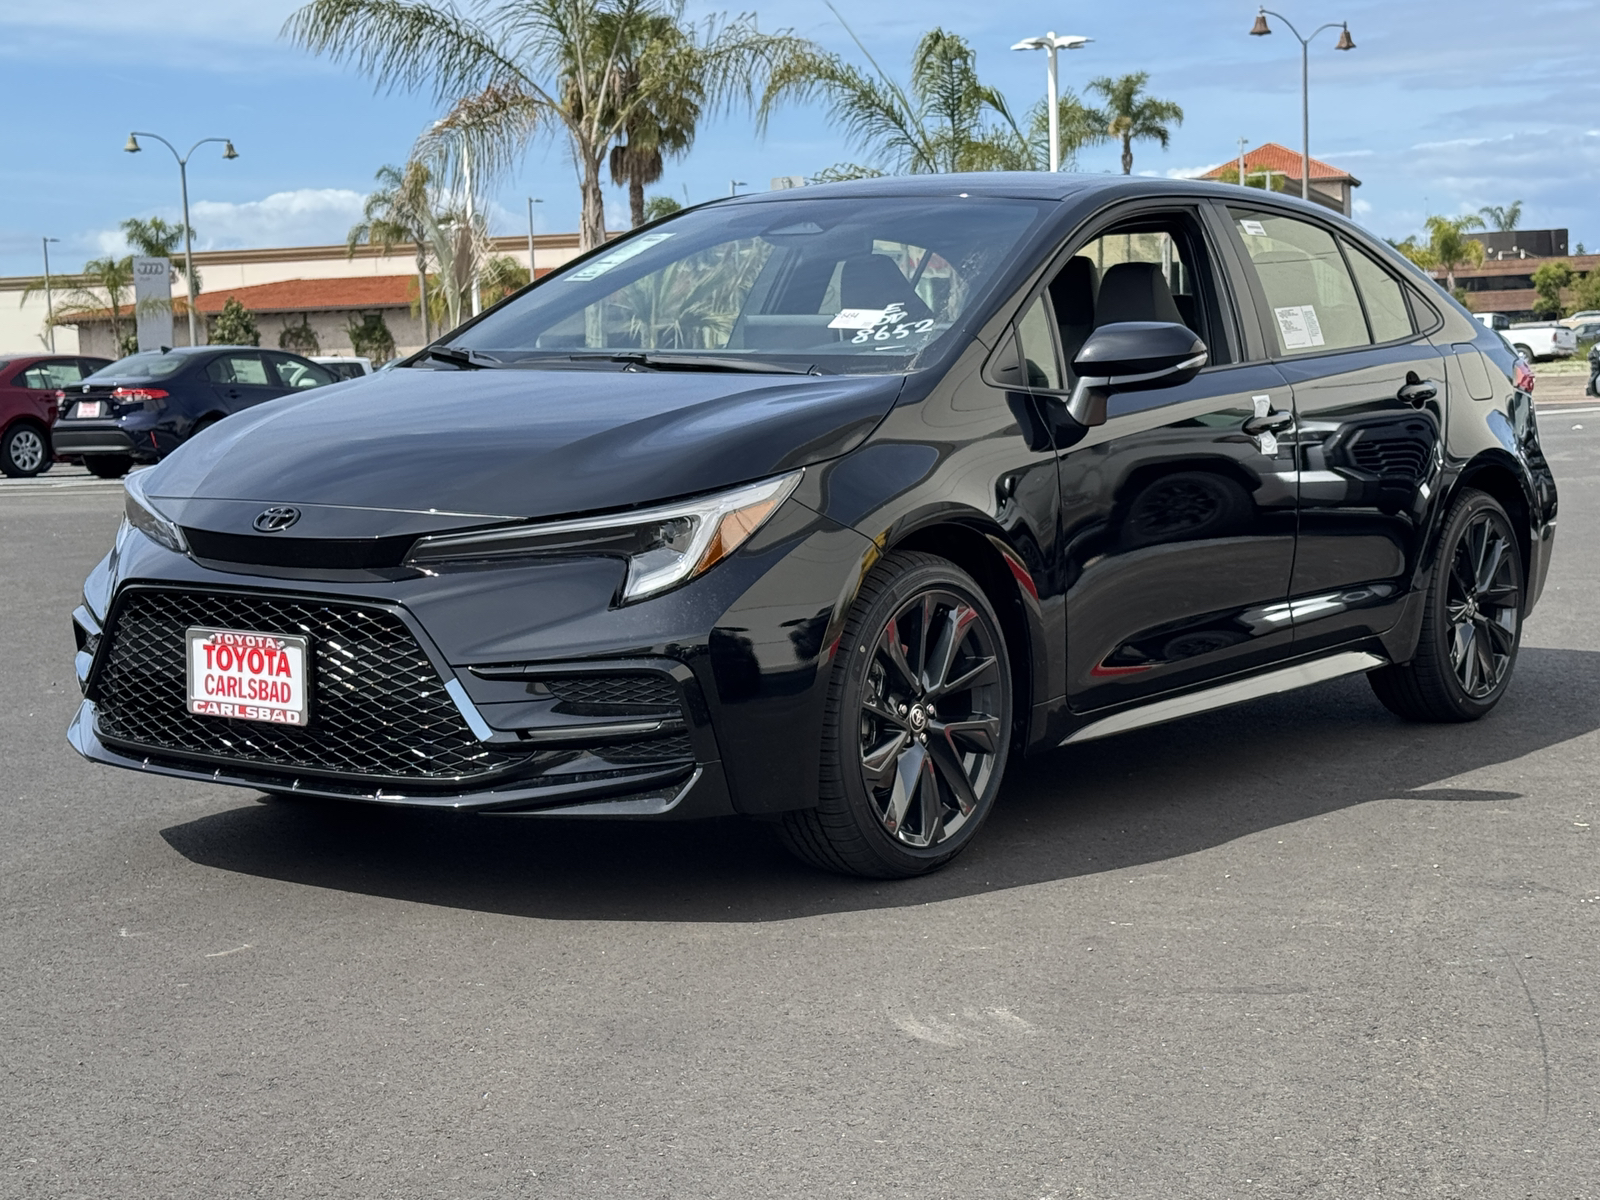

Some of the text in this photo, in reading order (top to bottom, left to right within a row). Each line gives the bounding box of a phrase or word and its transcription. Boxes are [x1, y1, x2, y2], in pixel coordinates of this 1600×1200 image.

[851, 319, 934, 343] 8652
[214, 633, 277, 649] TOYOTA
[203, 644, 292, 678] TOYOTA
[204, 674, 291, 703] CARLSBAD
[192, 700, 300, 723] CARLSBAD
